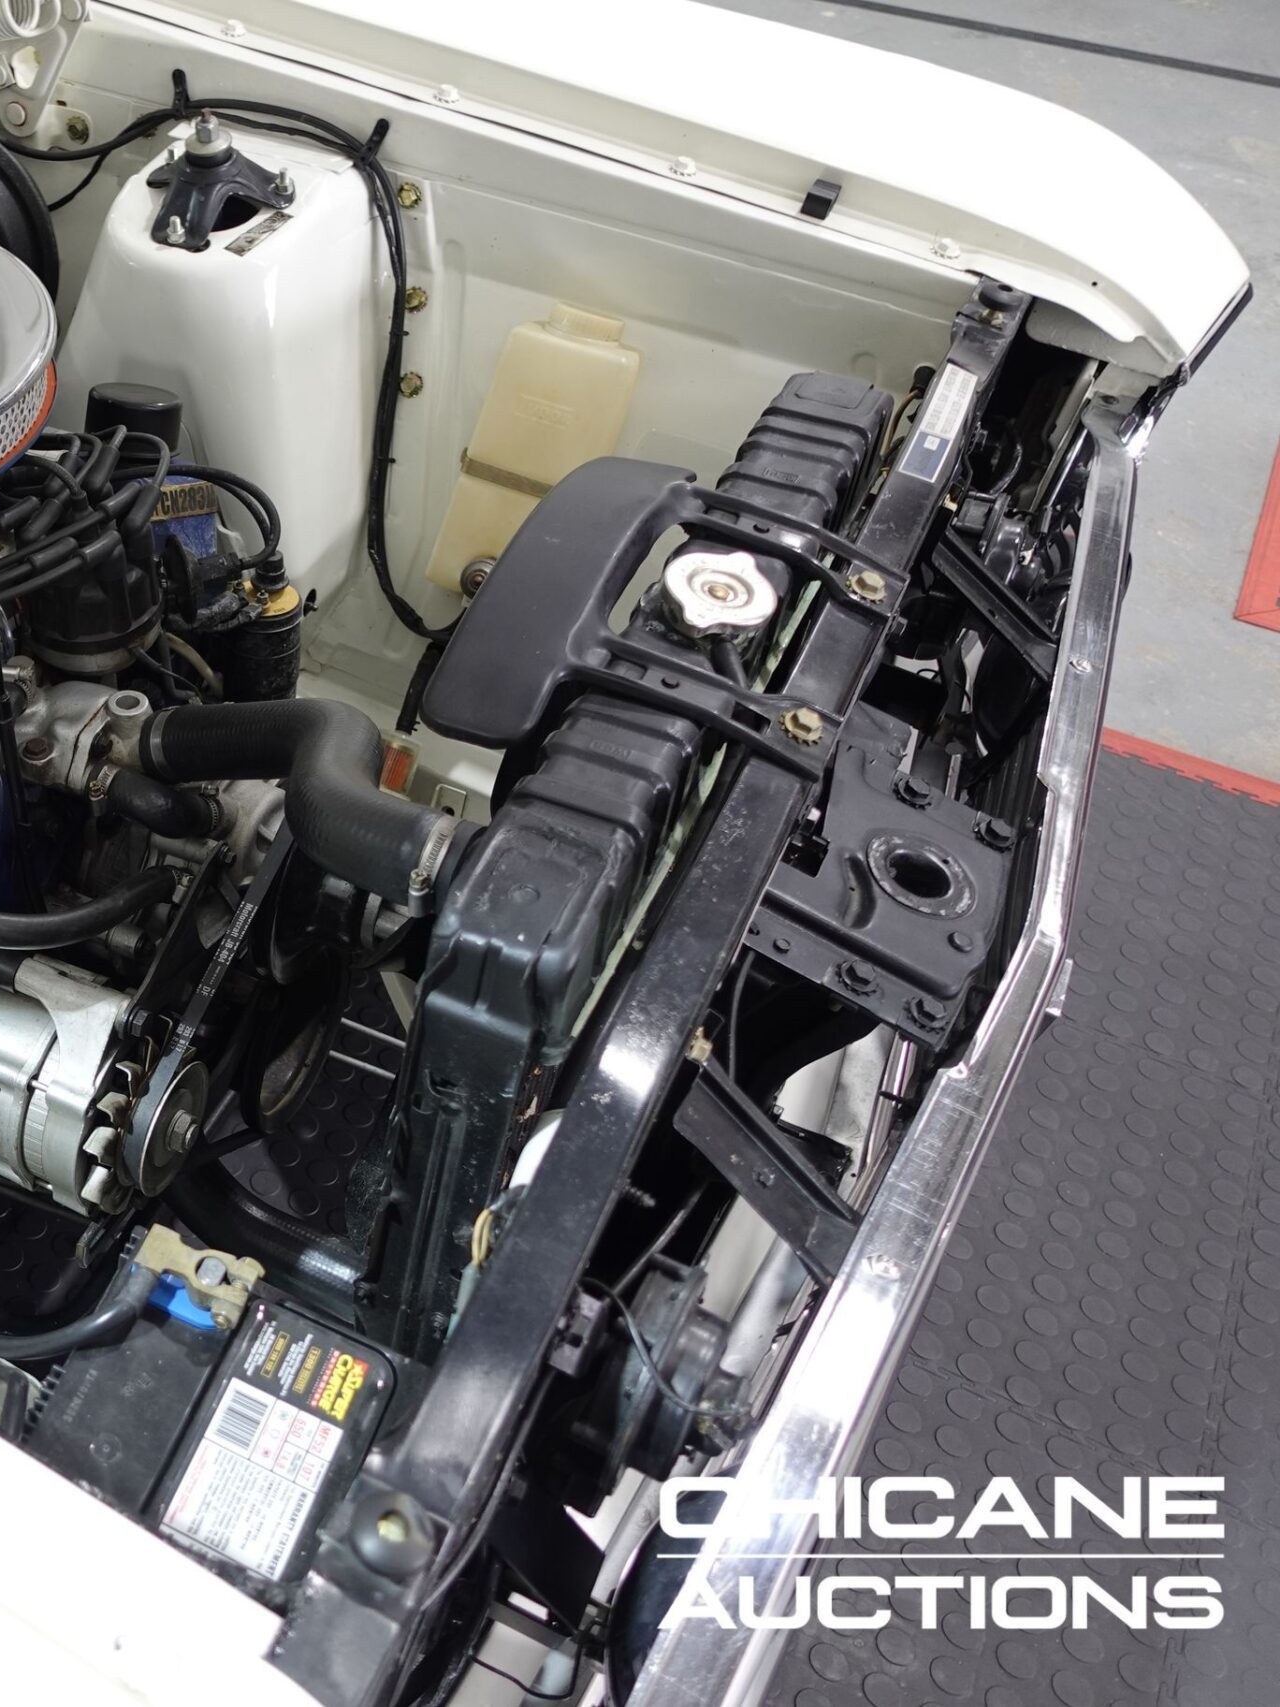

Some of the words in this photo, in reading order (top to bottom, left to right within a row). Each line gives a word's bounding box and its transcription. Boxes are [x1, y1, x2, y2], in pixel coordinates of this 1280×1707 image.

[231, 903, 254, 938] Motorcraft
[318, 1353, 354, 1413] CHARGE
[330, 1373, 364, 1420] SUPER
